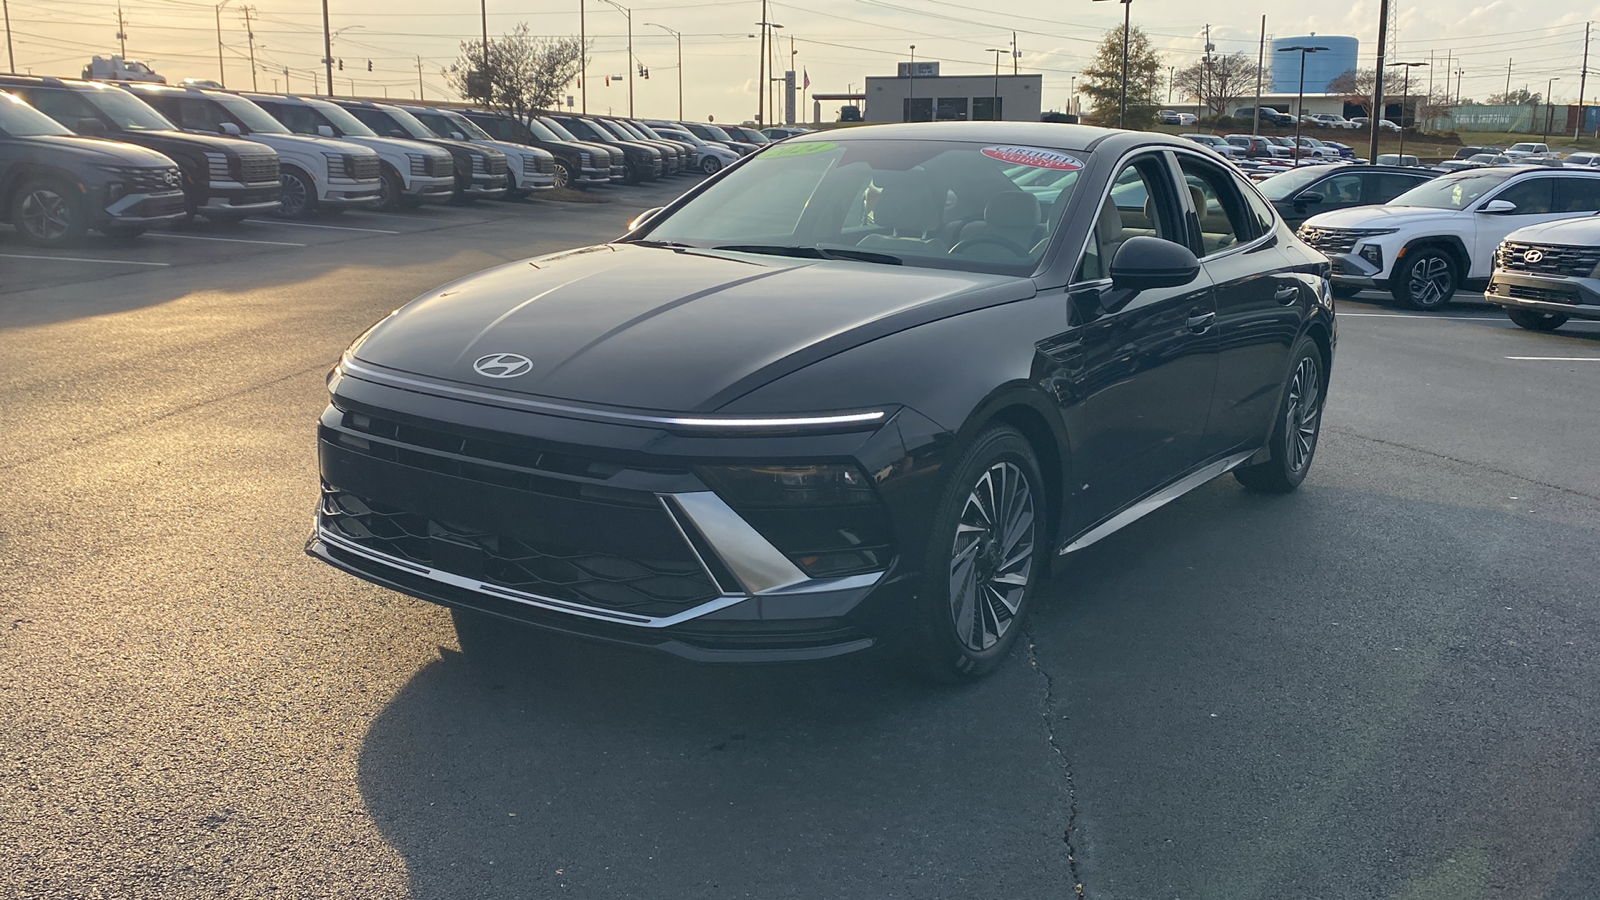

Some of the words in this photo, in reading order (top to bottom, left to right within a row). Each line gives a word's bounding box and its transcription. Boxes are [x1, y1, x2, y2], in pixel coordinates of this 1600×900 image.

[1455, 114, 1475, 124] CHINA
[1477, 114, 1510, 124] SHIPPING
[996, 147, 1076, 164] CERTIFIED
[1002, 155, 1052, 168] VEHICLE
